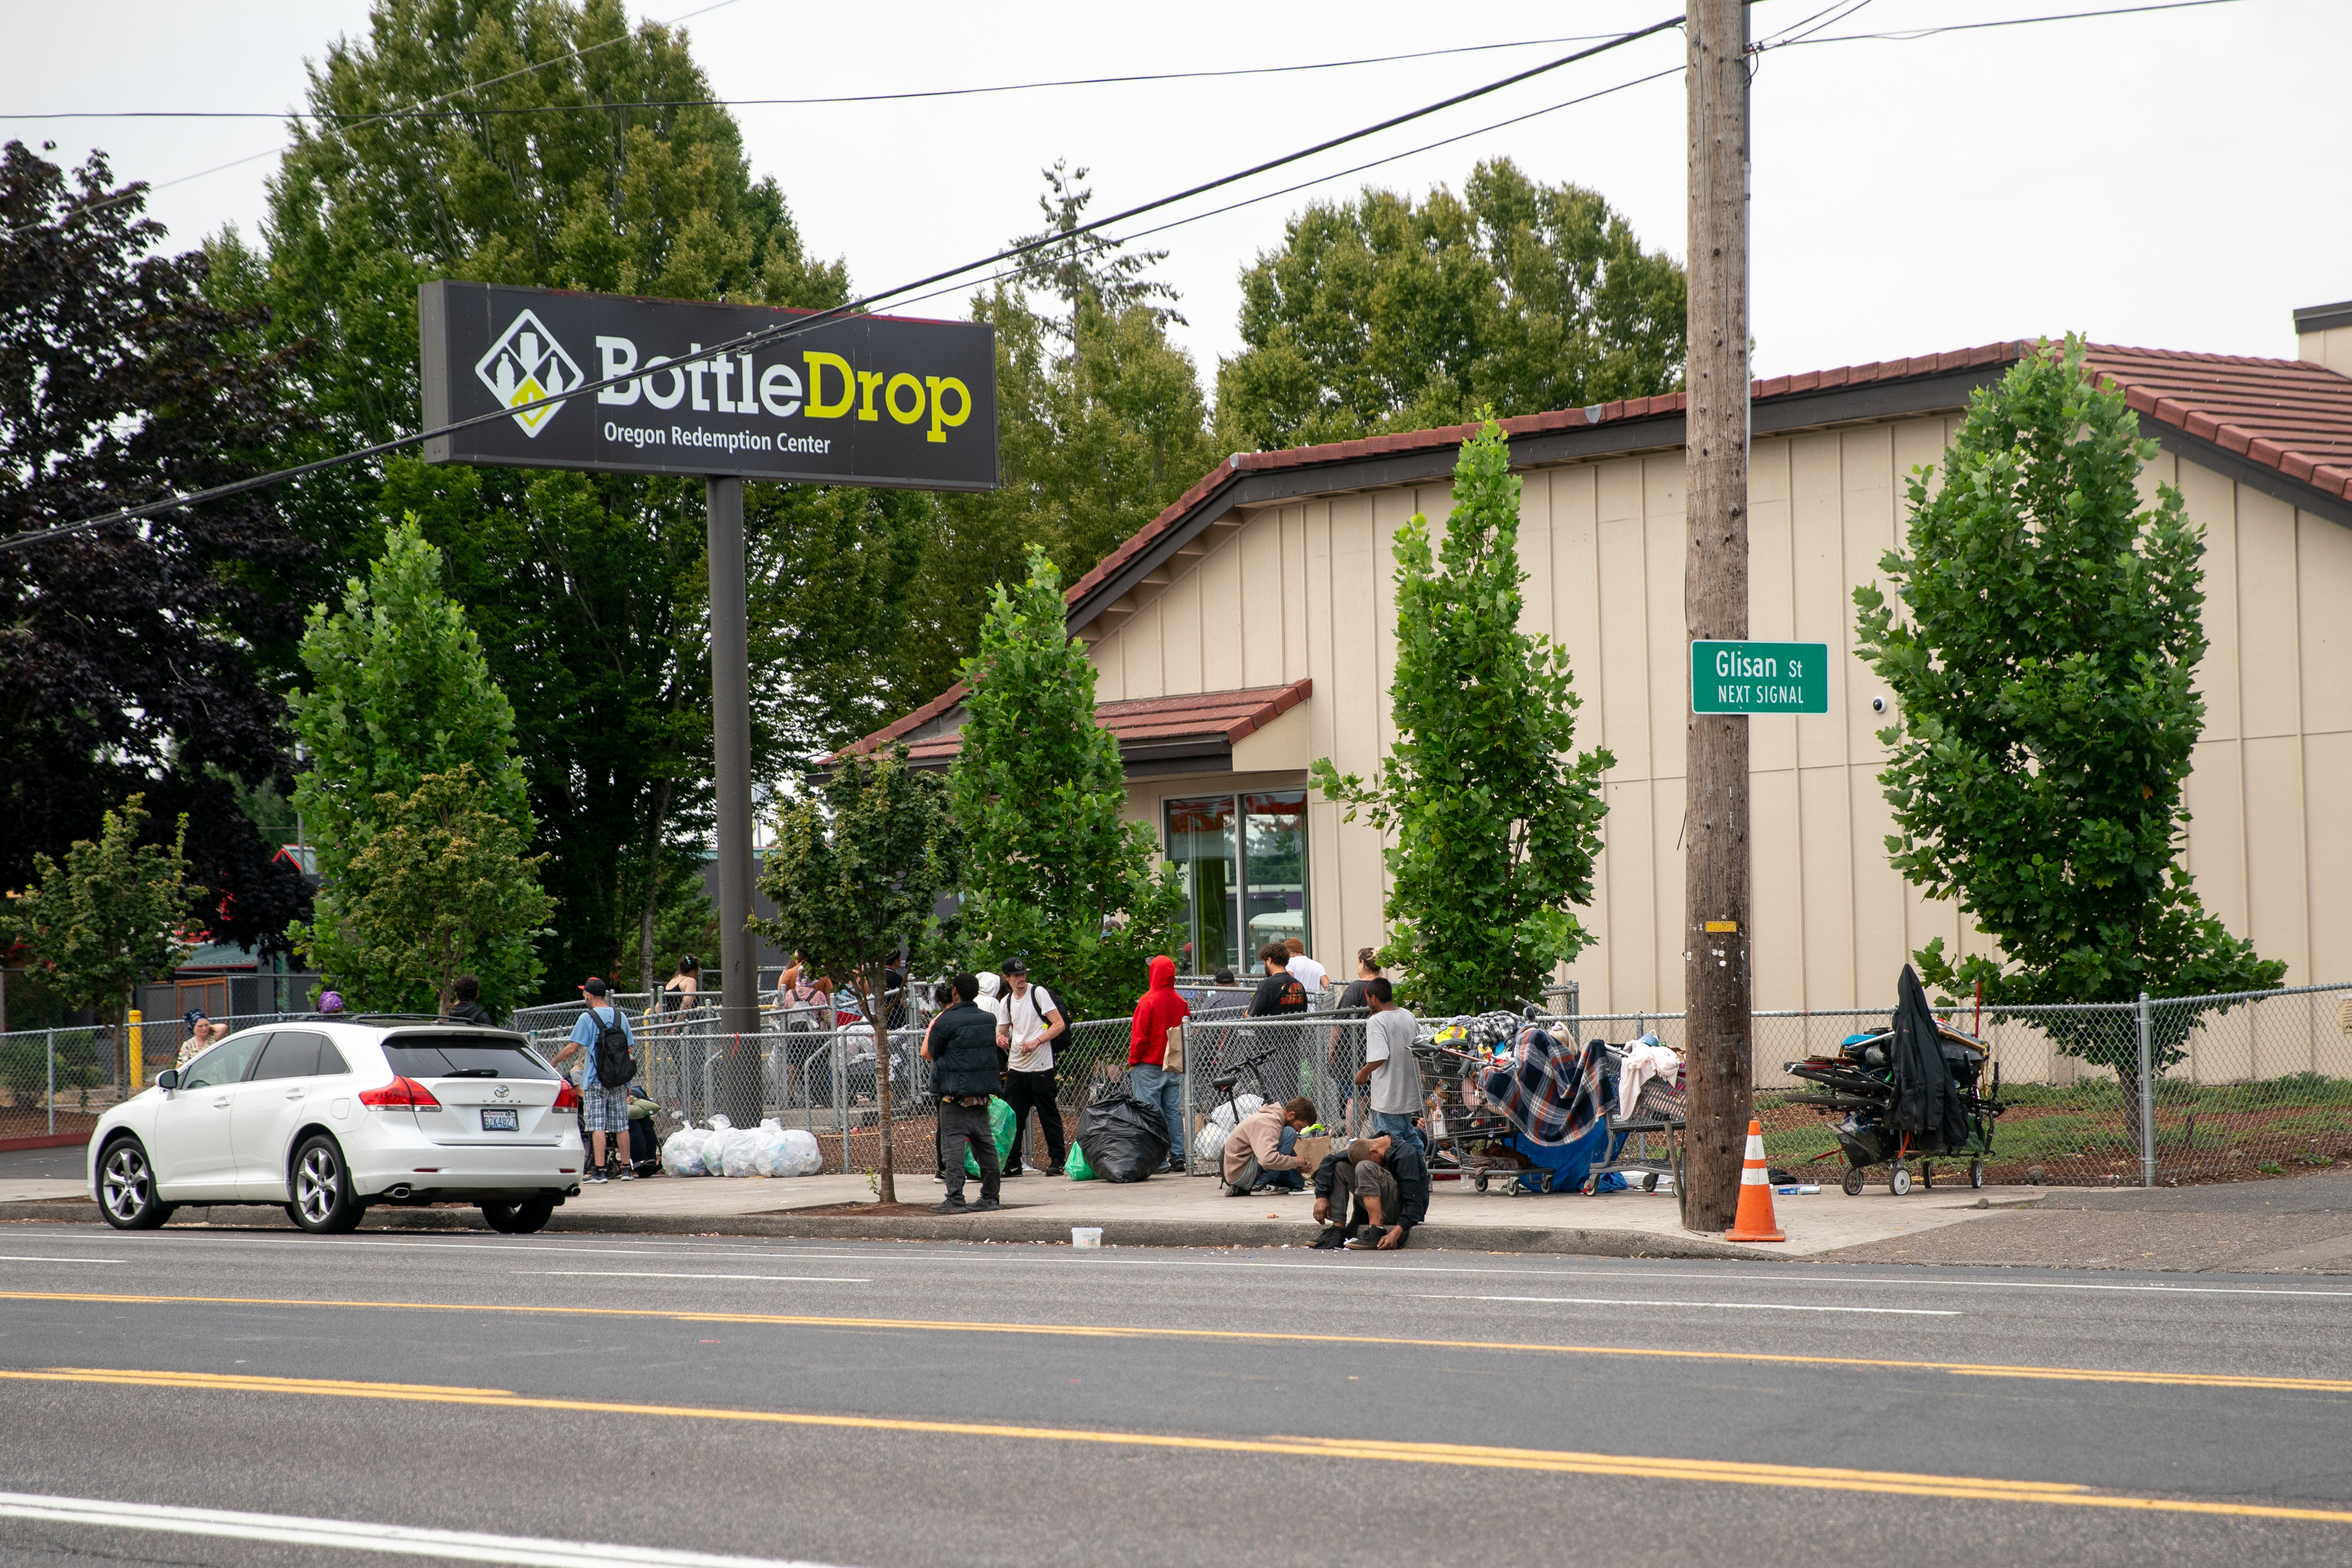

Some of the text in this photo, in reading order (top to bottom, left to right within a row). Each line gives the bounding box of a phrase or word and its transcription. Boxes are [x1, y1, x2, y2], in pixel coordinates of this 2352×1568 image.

[595, 335, 972, 443] BottleDrop
[604, 421, 831, 455] Oregon Redemption Center
[1716, 650, 1803, 678] Glisan St
[1718, 685, 1804, 704] NEXT SIGNAL
